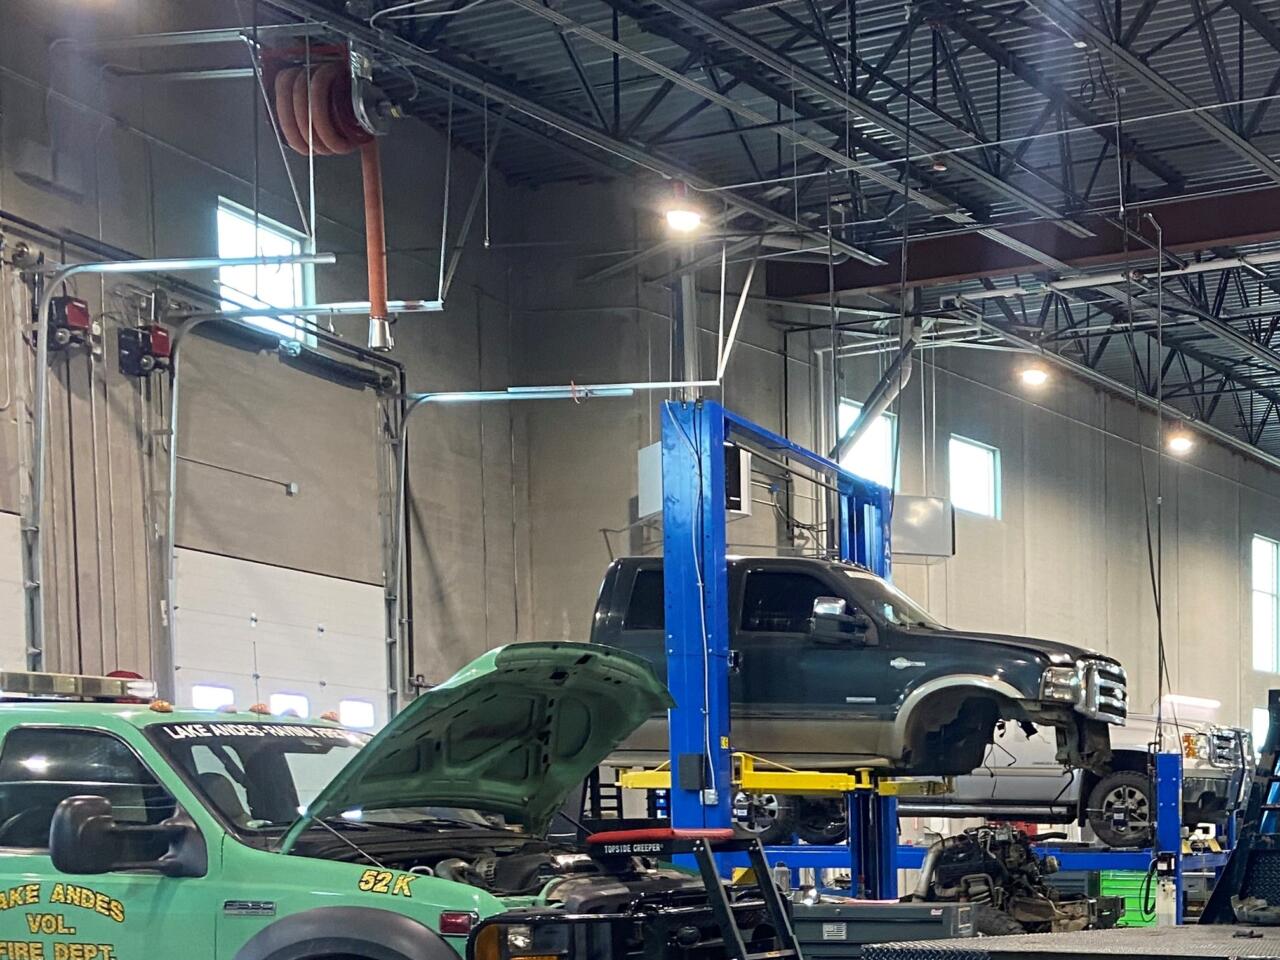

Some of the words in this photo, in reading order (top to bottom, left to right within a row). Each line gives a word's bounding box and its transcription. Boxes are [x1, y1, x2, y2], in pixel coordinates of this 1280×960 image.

[163, 725, 213, 740] LAKE
[604, 844, 631, 853] TOPSIDE
[49, 883, 125, 923] ANDES
[25, 913, 77, 935] VOL.
